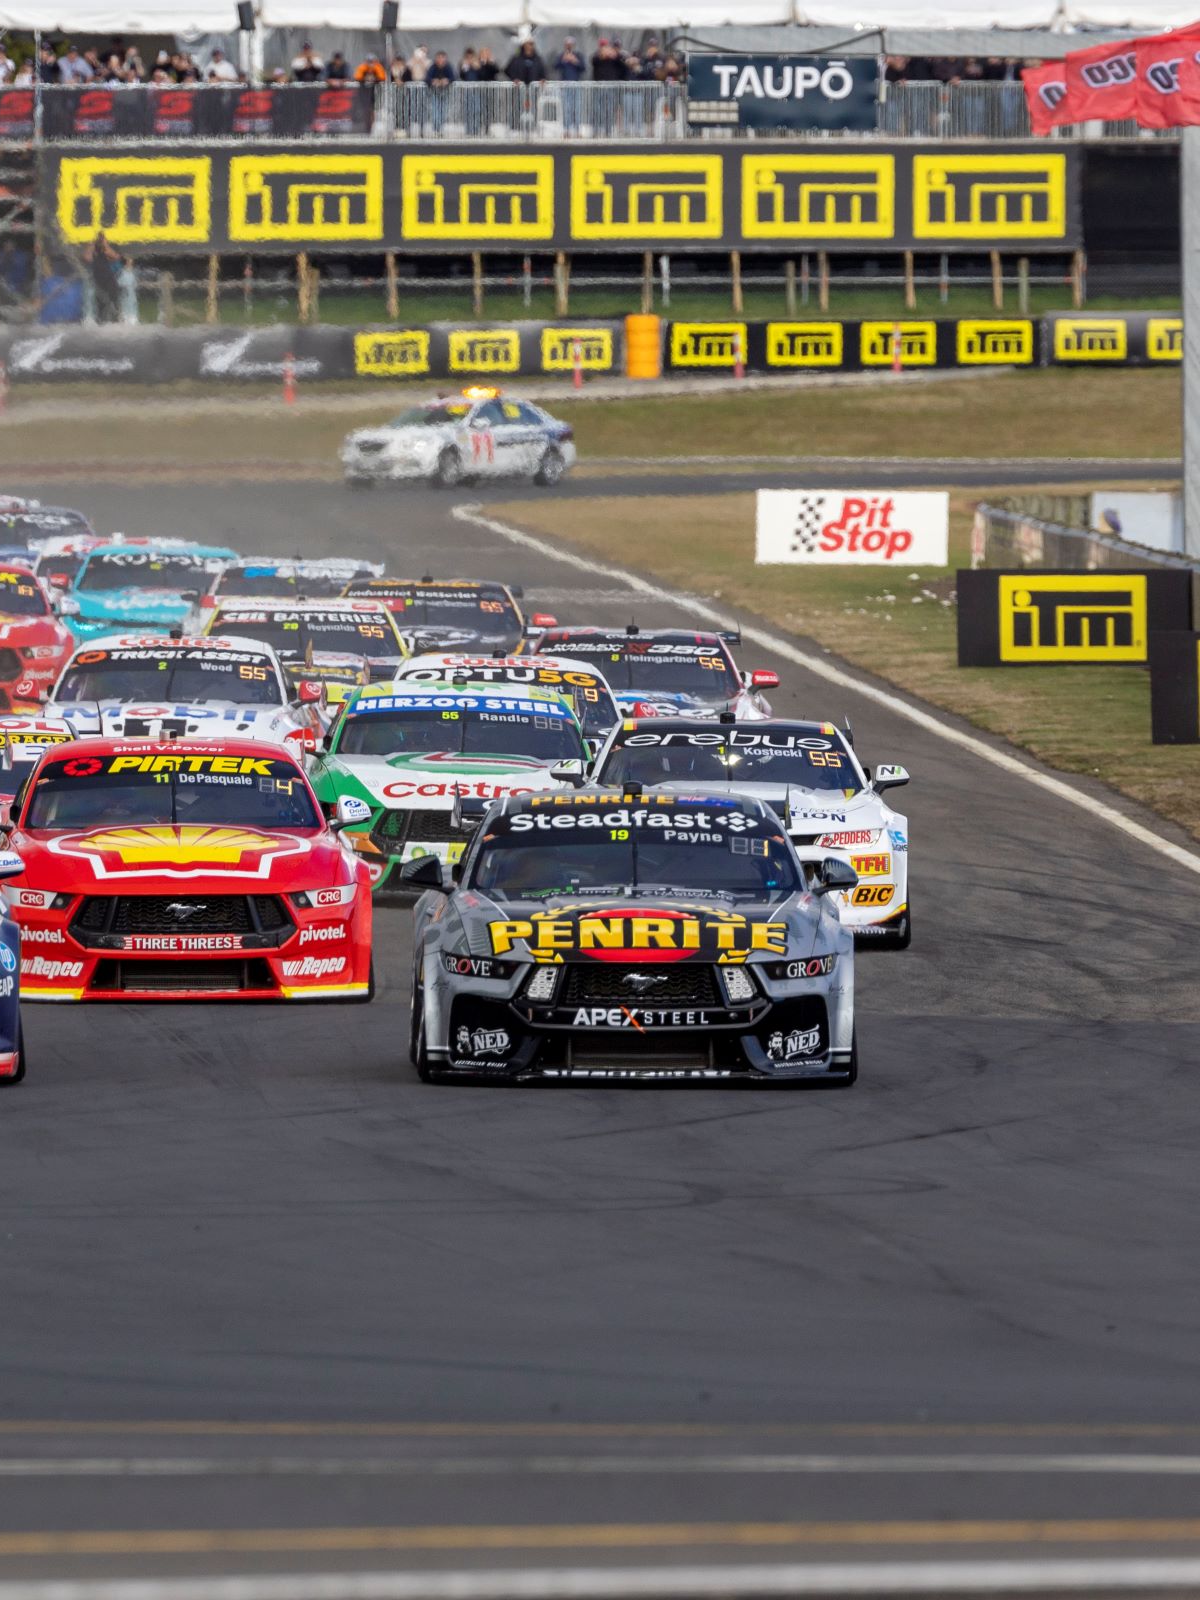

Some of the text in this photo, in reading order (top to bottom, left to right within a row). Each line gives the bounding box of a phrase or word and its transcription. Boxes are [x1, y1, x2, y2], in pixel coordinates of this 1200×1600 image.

[712, 60, 854, 100] TAUPŌ
[839, 498, 894, 529] Pit
[818, 522, 913, 559] Stop
[274, 613, 387, 625] BATTERIES
[110, 650, 266, 664] TRUCK ASSIST
[158, 661, 233, 673] 2 Wood
[239, 665, 268, 681] 55
[62, 706, 259, 723] Mobil
[356, 697, 565, 716] HERZOG STEEL
[441, 711, 529, 724] 55 Randle
[624, 730, 833, 751] erebus
[113, 745, 225, 753] Shell V-Power
[743, 747, 803, 758] Kostecki
[108, 756, 275, 776] PIRTEK
[809, 752, 842, 768] 55
[154, 774, 170, 784] 11
[382, 782, 552, 798] Castro
[531, 794, 675, 806] PENRITE
[510, 810, 711, 831] Steadfast
[610, 829, 723, 843] 19 Payne
[834, 830, 872, 846] PEDDERS
[854, 856, 885, 872] TFH
[20, 892, 44, 906] CRC
[318, 890, 342, 903] CRC
[134, 936, 233, 950] THREE THREES
[488, 916, 789, 957] PENRITE
[33, 957, 84, 978] Repco
[303, 957, 347, 977] Repco
[446, 957, 491, 977] GROVE
[787, 958, 832, 978] GROVE
[573, 1005, 709, 1029] APEX STEEL
[474, 1032, 510, 1051] NED
[786, 1032, 821, 1053] NED
